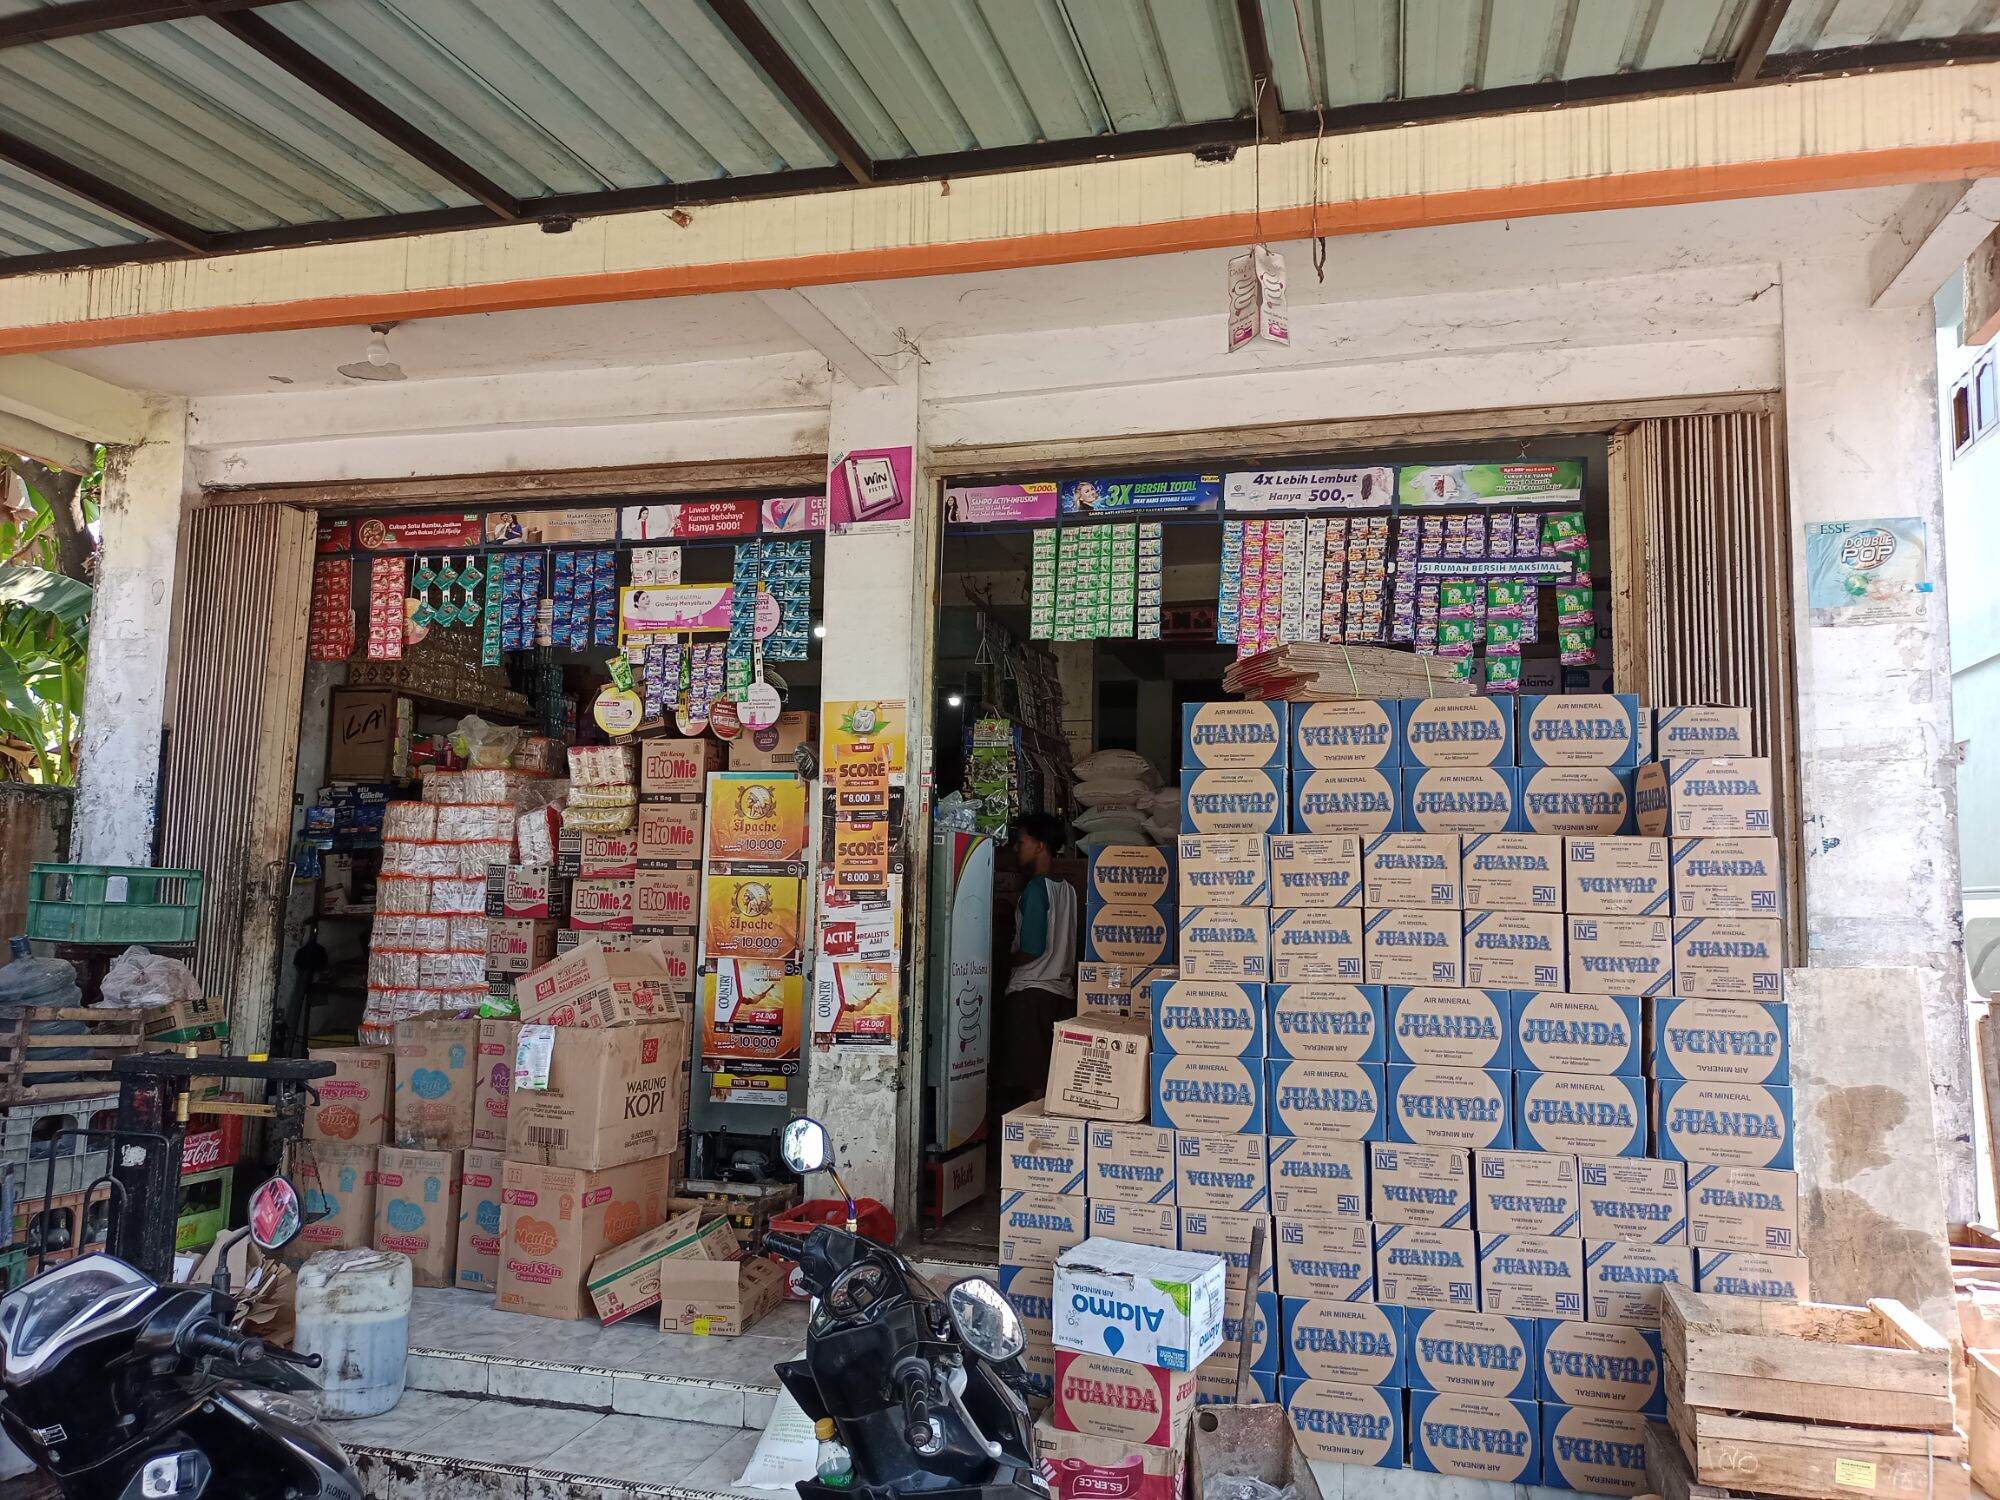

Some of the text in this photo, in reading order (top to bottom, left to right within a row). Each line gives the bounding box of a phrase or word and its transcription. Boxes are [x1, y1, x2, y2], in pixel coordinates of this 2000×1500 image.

[864, 472, 887, 486] WIN
[1253, 473, 1358, 485] 4x Lebih Lembut
[869, 485, 888, 493] FILTER
[1107, 481, 1196, 506] 3X BERSIH TOTAL
[1269, 489, 1353, 503] Hanya 500,-
[688, 504, 736, 514] Lawan 99.9%
[688, 522, 740, 532] Hanya 5000!
[1820, 523, 1850, 534] ESSE
[1844, 536, 1893, 548] DOUBLE
[1841, 545, 1894, 564] POP
[1434, 564, 1469, 572] RUMAH
[1472, 564, 1506, 572] BERSIH
[1509, 564, 1561, 572] MAKSIMAL
[1520, 678, 1554, 688] Alamo
[1227, 708, 1254, 716] MINERAL
[1447, 704, 1478, 712] MINERAL
[1556, 702, 1602, 710] AIR MINERAL
[1192, 722, 1278, 746] JUANDA
[1301, 722, 1390, 746] JUANDA
[1410, 720, 1502, 743] JUANDA
[1531, 718, 1630, 742] JUANDA
[840, 763, 886, 778] SCORE
[848, 793, 870, 803] 8.000
[1682, 780, 1761, 798] JUANDA
[1190, 792, 1276, 814] JUANDA
[1302, 791, 1392, 814] JUANDA
[1415, 791, 1509, 814] JUANDA
[1526, 792, 1628, 816] JUANDA
[734, 820, 776, 834] Apache
[1746, 812, 1769, 826] SNI
[838, 842, 884, 856] SCORE
[847, 872, 869, 882] 8.000
[1096, 864, 1167, 885] JUANDA
[1188, 870, 1256, 886] JUANDA
[1432, 884, 1454, 900] SNI
[730, 916, 773, 930] Apache
[826, 930, 853, 945] ACTIF
[1189, 926, 1258, 944] JUANDA
[1535, 966, 1558, 982] SNI
[1753, 973, 1778, 989] SNI
[718, 974, 730, 1009] COUNTRY
[818, 980, 830, 1018] COUNTRY
[1186, 990, 1229, 998] AIR MINERAL
[1423, 996, 1472, 1005] AIR MINERAL
[1549, 1002, 1600, 1011] AIR MINERAL
[756, 1012, 777, 1020] 24.000
[1163, 1005, 1252, 1031] JUANDA
[1277, 1010, 1372, 1035] JUANDA
[1398, 1012, 1500, 1040] JUANDA
[1522, 1018, 1628, 1047] JUANDA
[1302, 1044, 1348, 1052] AIR MINERAL
[1667, 1028, 1777, 1057] JUANDA
[1696, 1064, 1733, 1073] MINERAL
[626, 1076, 666, 1093] WARUNG
[1162, 1078, 1252, 1106] JUANDA
[486, 1100, 508, 1112] Good
[624, 1092, 664, 1120] KOPI
[1279, 1086, 1376, 1113] JUANDA
[1400, 1094, 1502, 1122] JUANDA
[1526, 1099, 1634, 1128] JUANDA
[1670, 1107, 1782, 1139] JUANDA
[1010, 1154, 1074, 1174] JUANDA
[952, 1162, 974, 1191] Yakult
[517, 1192, 535, 1200] Allergy
[518, 1198, 535, 1206] Tested
[1489, 1194, 1568, 1214] JUANDA
[1701, 1188, 1784, 1211] JUANDA
[381, 1234, 429, 1249] Good Skin
[514, 1229, 558, 1249] Merries
[534, 1262, 562, 1278] Skin
[1492, 1256, 1571, 1279] JUANDA
[1072, 1294, 1165, 1332] Alamo
[1199, 1324, 1220, 1348] Alamo
[1295, 1326, 1394, 1358] JUANDA
[1418, 1336, 1522, 1372] JUANDA
[1546, 1348, 1655, 1385] JUANDA
[1064, 1376, 1160, 1415] JUANDA
[1290, 1406, 1392, 1440] JUANDA
[1424, 1421, 1528, 1457] JUANDA
